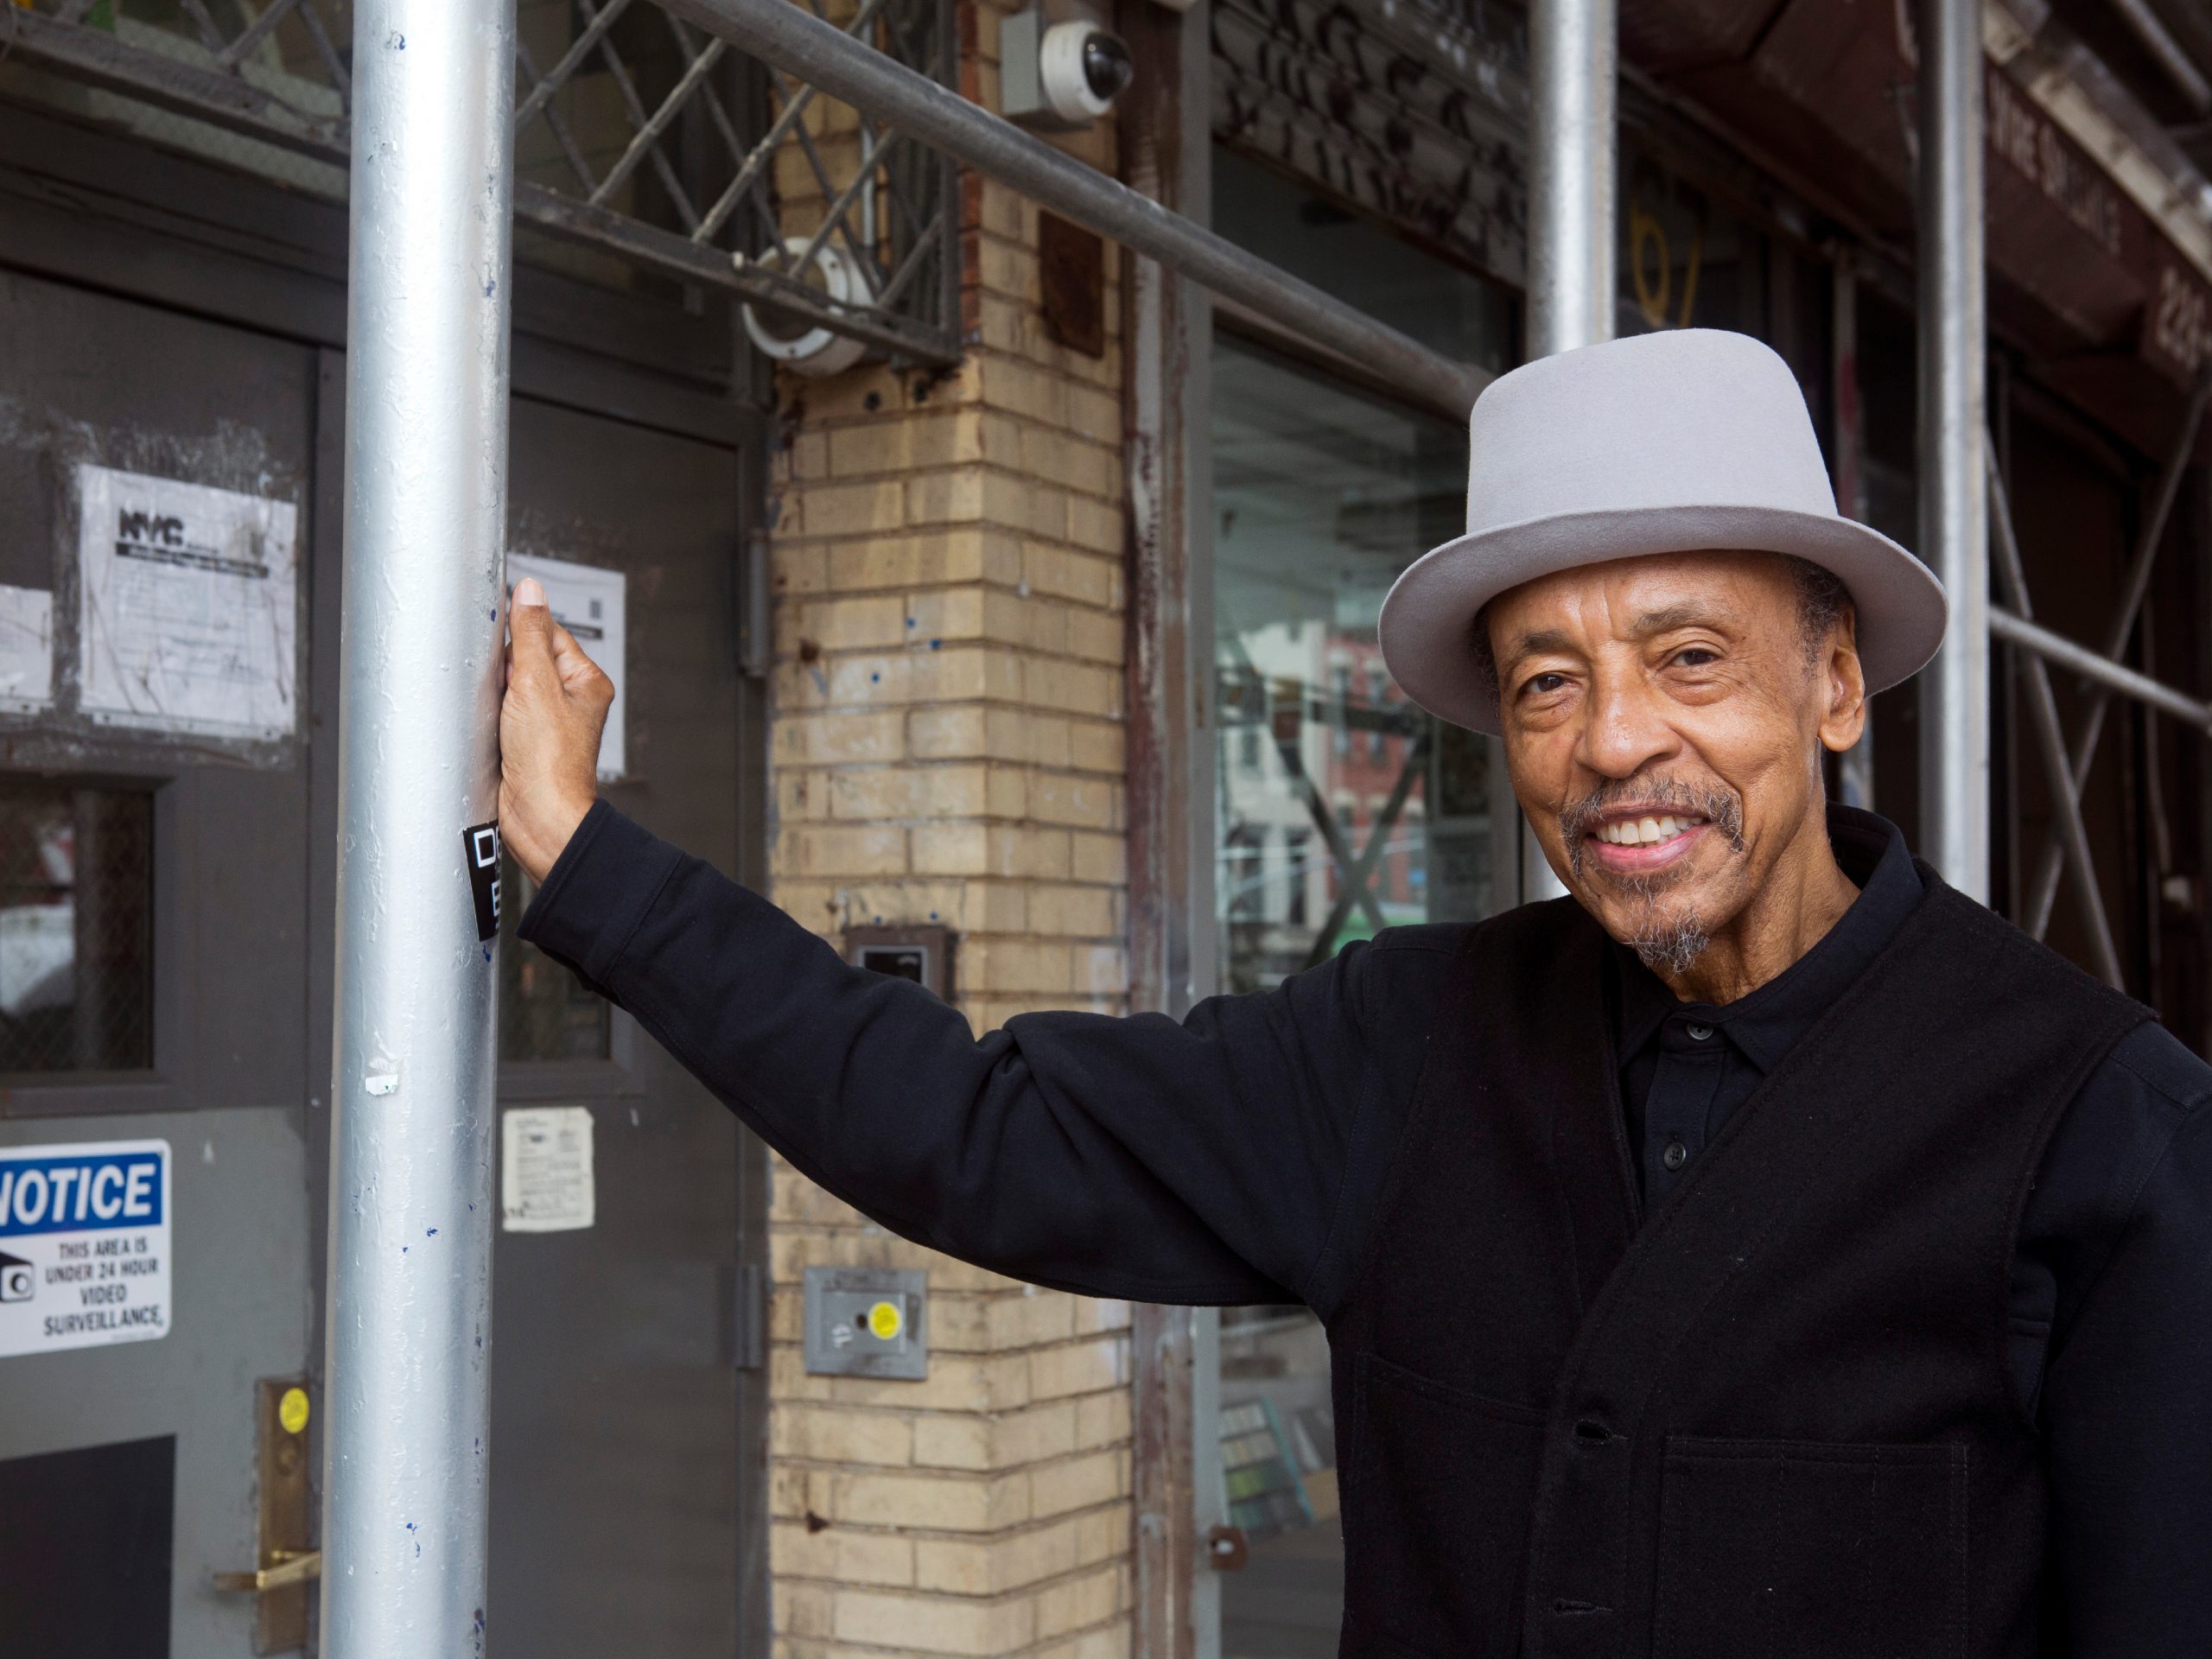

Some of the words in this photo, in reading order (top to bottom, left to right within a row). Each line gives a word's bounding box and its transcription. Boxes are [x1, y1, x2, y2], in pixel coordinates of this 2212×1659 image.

[119, 508, 183, 545] NYC
[60, 1242, 89, 1260] THIS
[94, 1237, 130, 1256] AREA
[134, 1236, 148, 1253] IS
[45, 1263, 93, 1284] UNDER
[99, 1260, 116, 1279] 24
[120, 1256, 159, 1276] HOUR
[79, 1284, 127, 1306] VIDEO
